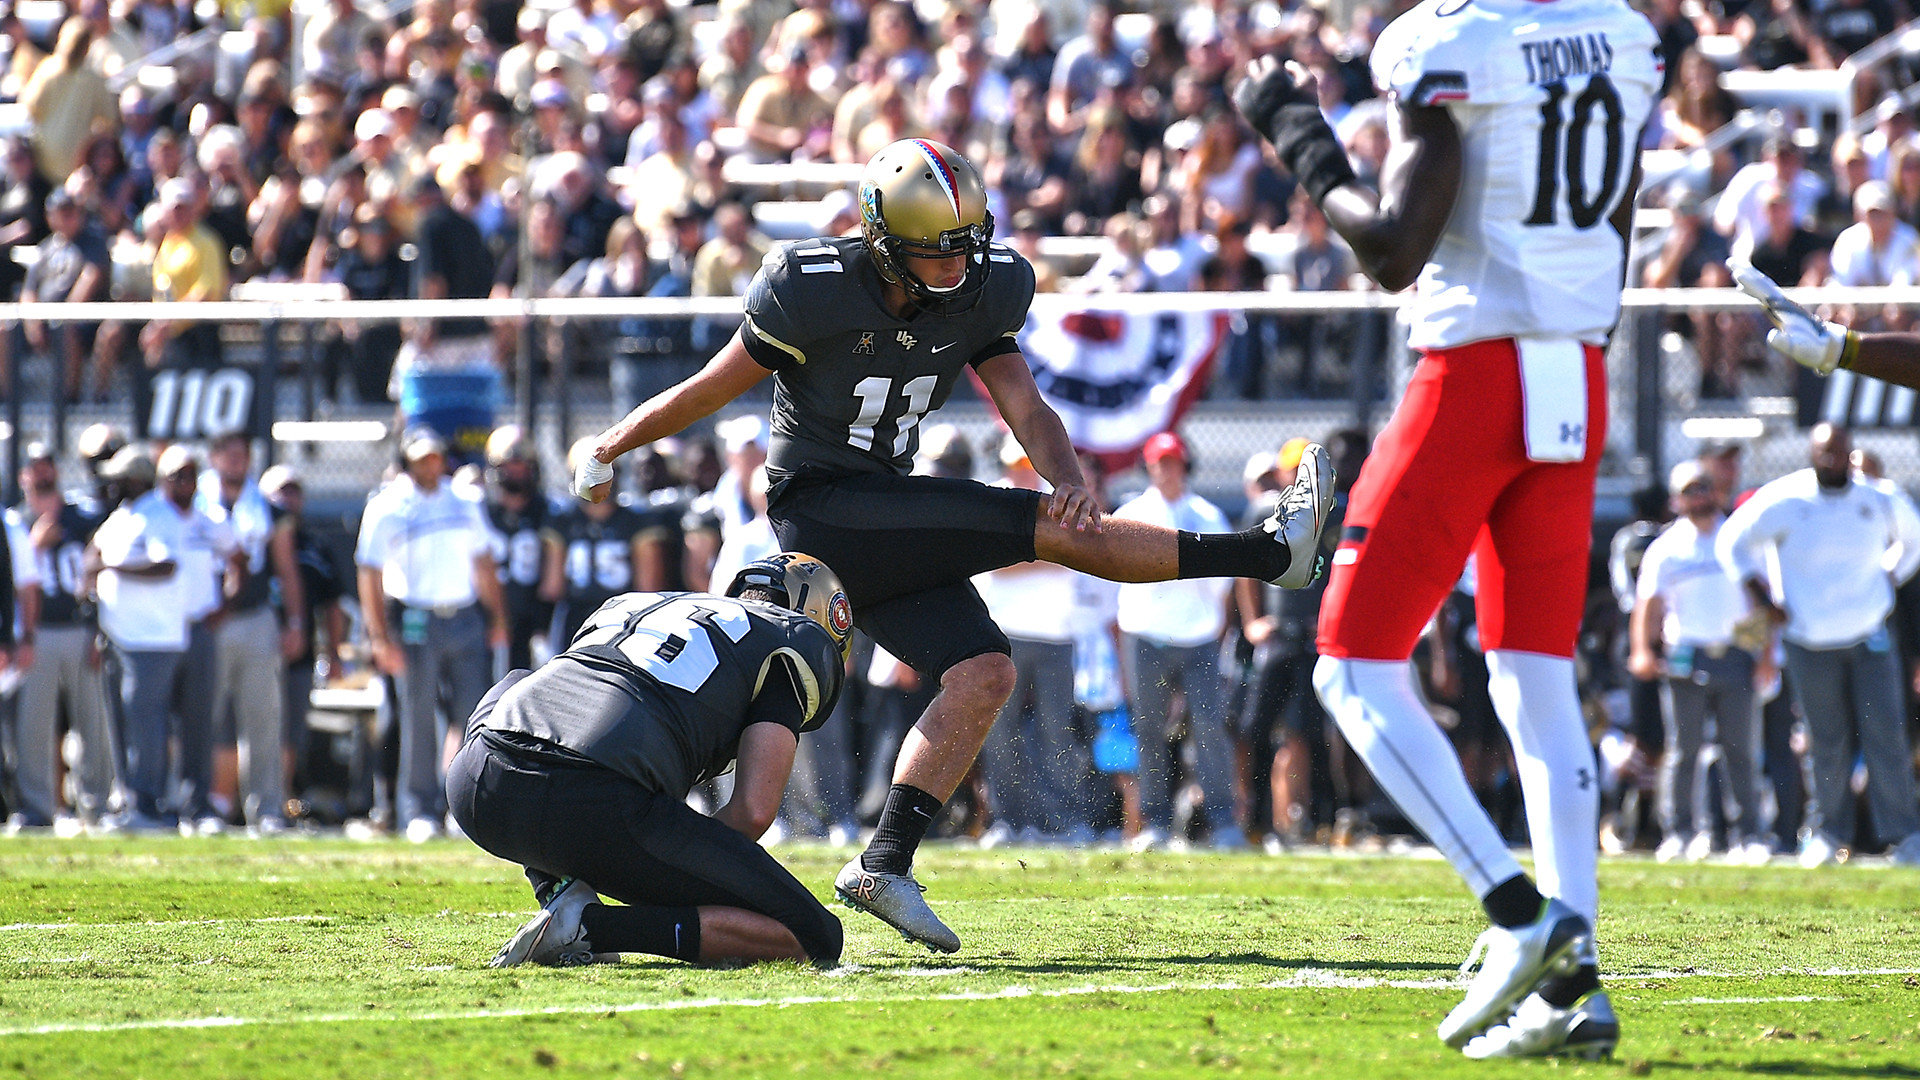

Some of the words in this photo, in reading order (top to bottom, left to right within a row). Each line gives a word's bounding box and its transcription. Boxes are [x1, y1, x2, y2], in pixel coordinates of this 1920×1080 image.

[1521, 32, 1613, 83] THOMAS
[1523, 72, 1625, 229] 10
[795, 245, 843, 274] 11
[896, 331, 917, 350] UCF
[148, 367, 254, 438] 110
[847, 375, 938, 458] 11
